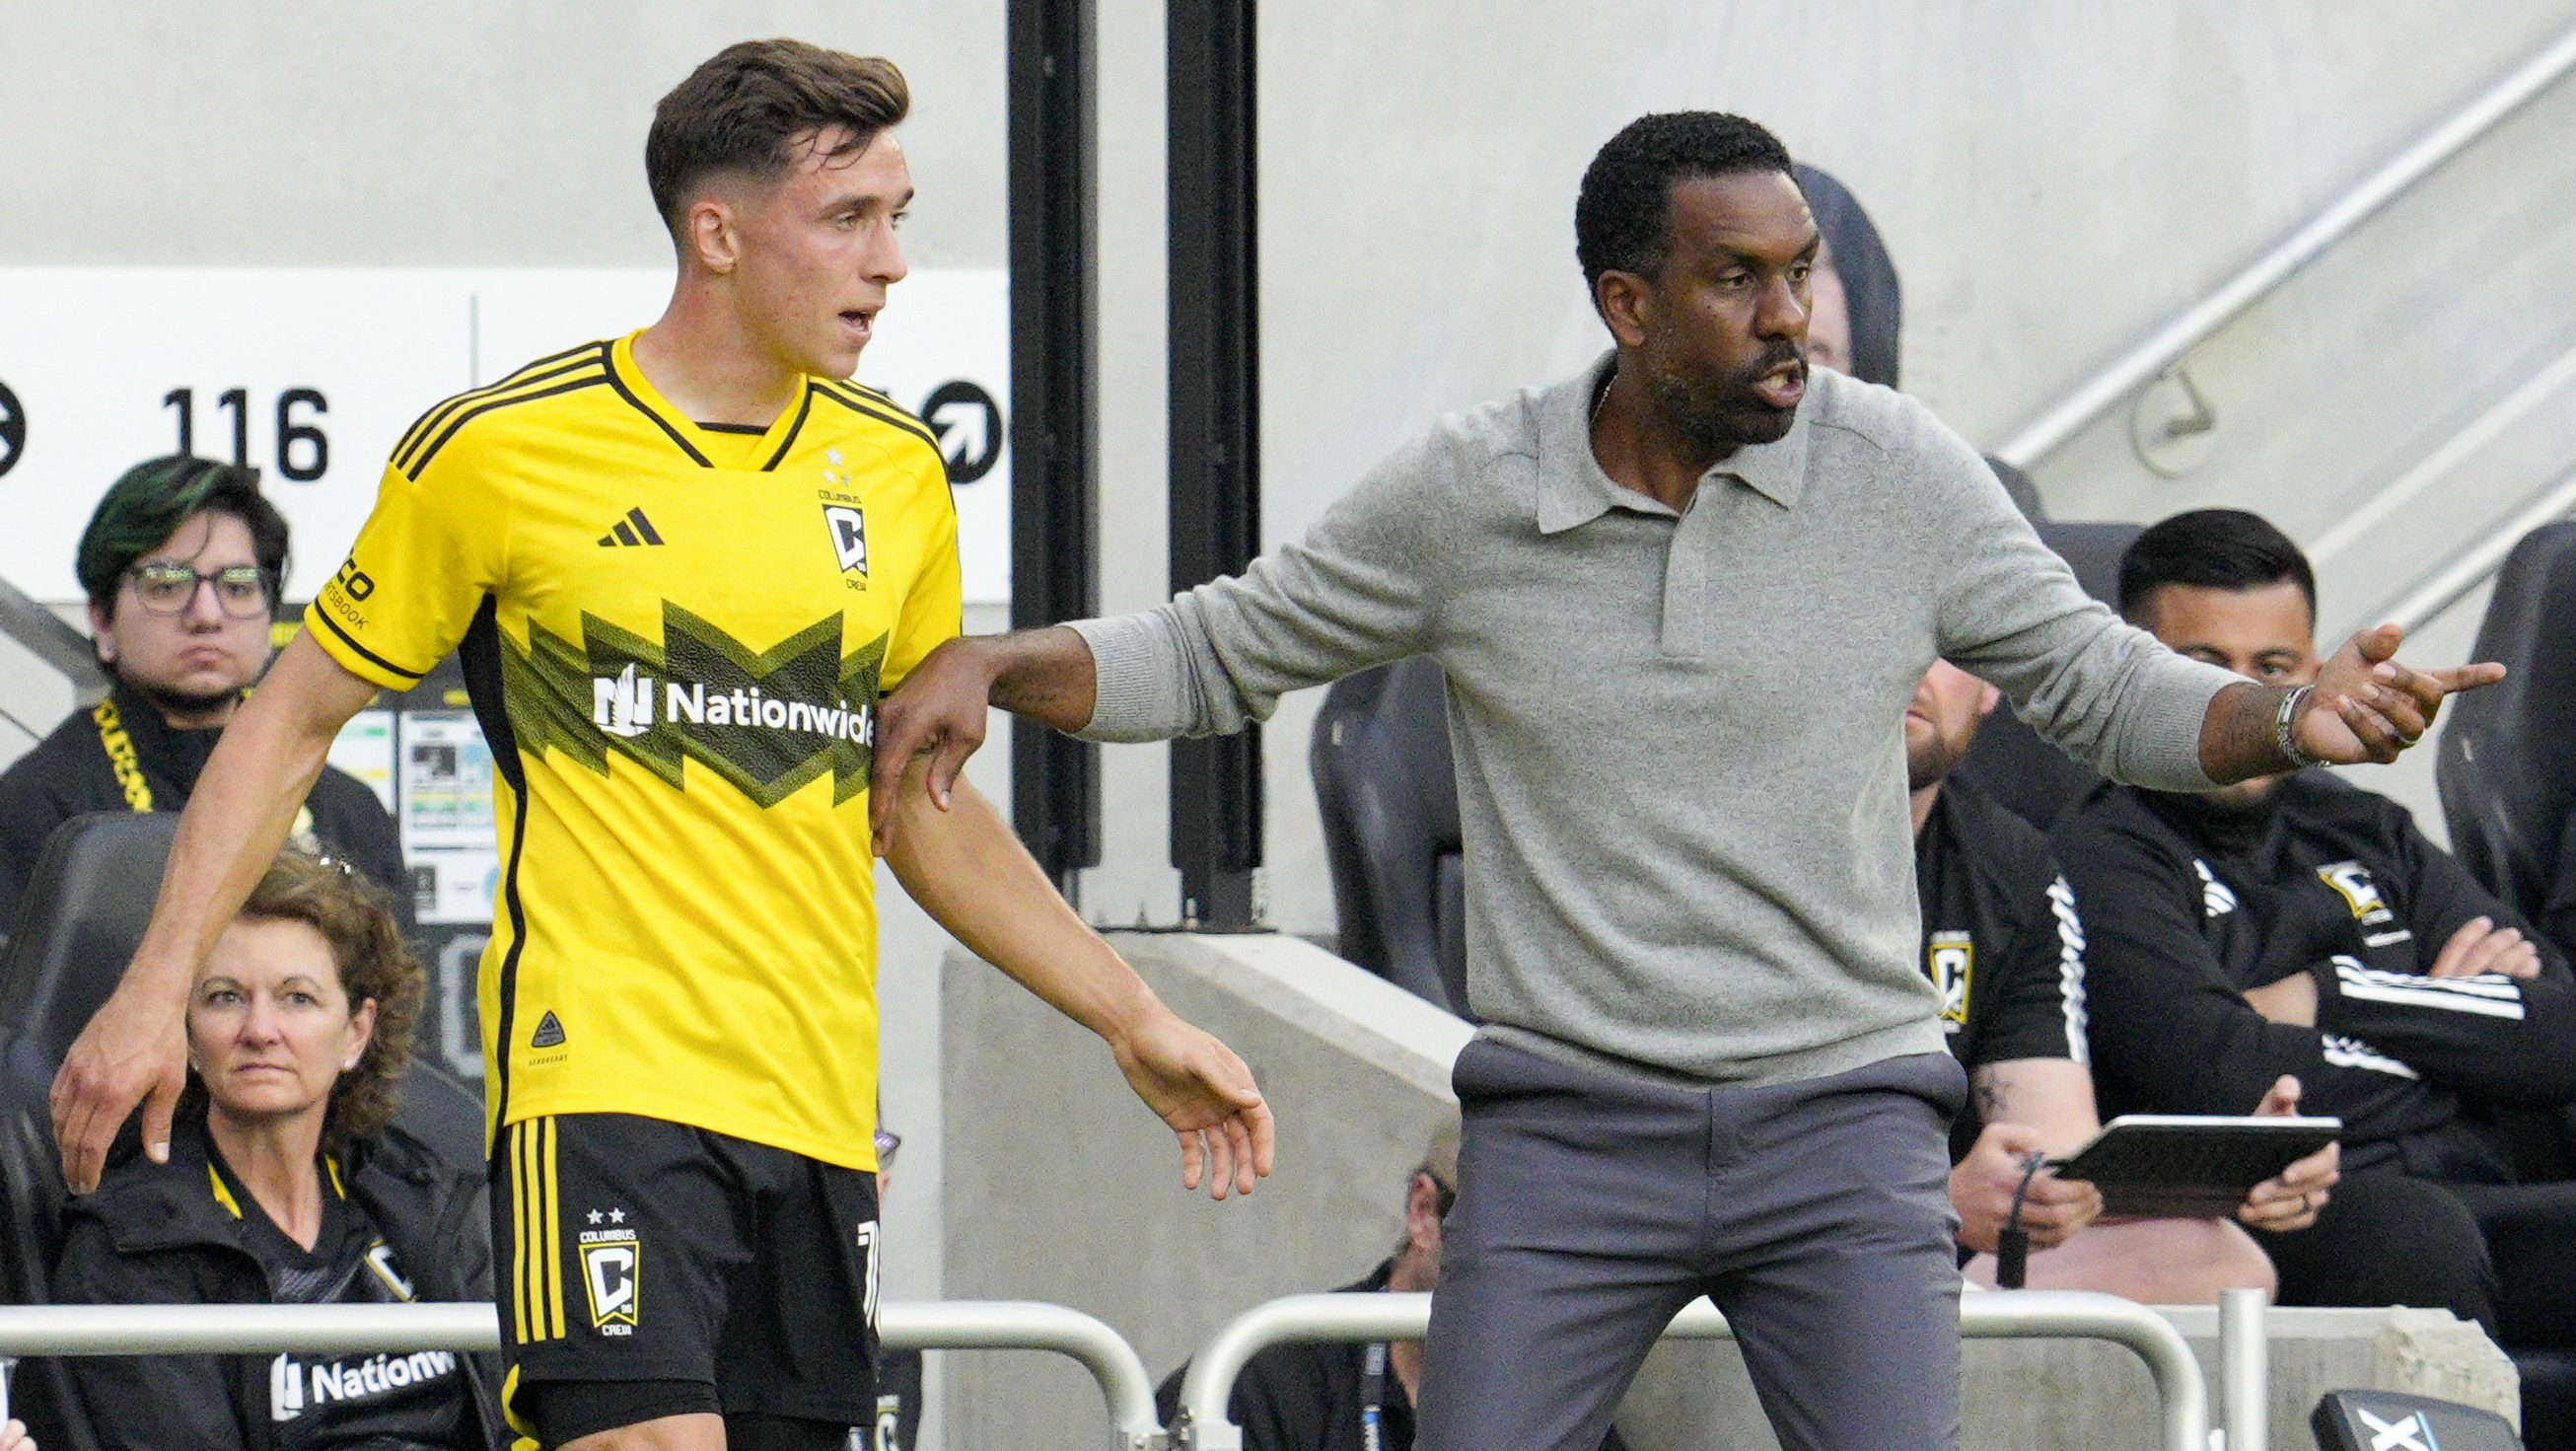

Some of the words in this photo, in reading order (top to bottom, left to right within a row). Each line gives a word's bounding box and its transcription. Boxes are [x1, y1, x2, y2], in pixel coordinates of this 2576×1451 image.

[163, 388, 328, 482] 116
[579, 1228, 637, 1243] COLUMBUS
[602, 1323, 632, 1337] CREW
